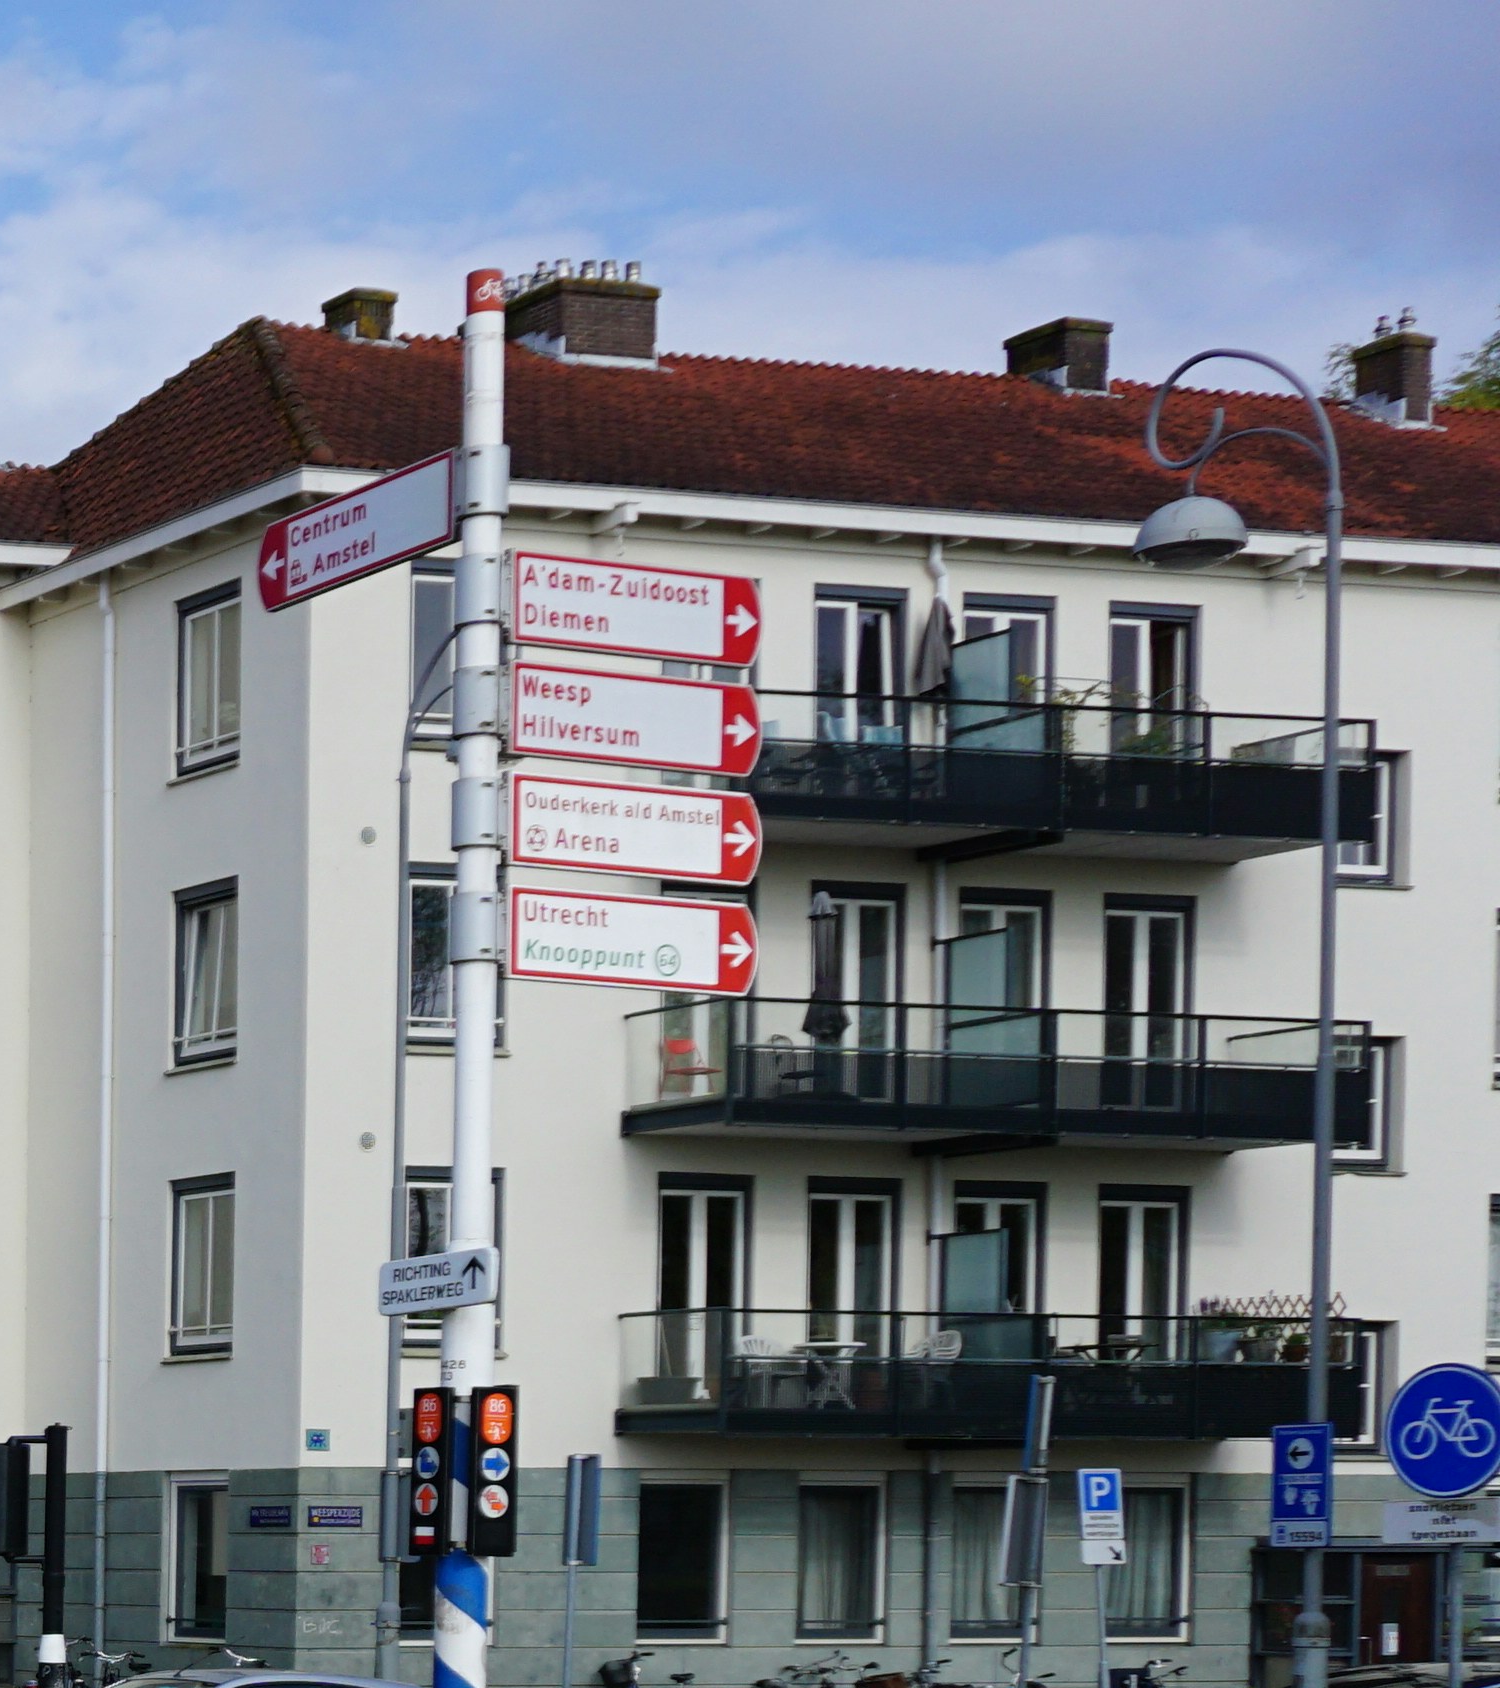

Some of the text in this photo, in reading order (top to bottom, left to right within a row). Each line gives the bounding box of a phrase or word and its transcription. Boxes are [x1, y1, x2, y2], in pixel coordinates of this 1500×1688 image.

[291, 503, 367, 547] Centrum
[313, 532, 376, 576] Amstel
[523, 564, 710, 606] A'dam-Zuidoost
[525, 603, 610, 633] Diemen
[522, 675, 592, 706] Weesp
[522, 714, 640, 747] Hilversum
[525, 791, 618, 817] Ouderkerk
[658, 804, 720, 826] Amstel
[554, 828, 620, 853] Arena
[524, 901, 609, 928] Utrecht
[525, 939, 646, 970] Knooppunt
[393, 1261, 451, 1283] RICHTING
[382, 1281, 464, 1306] SPAKLERWEG
